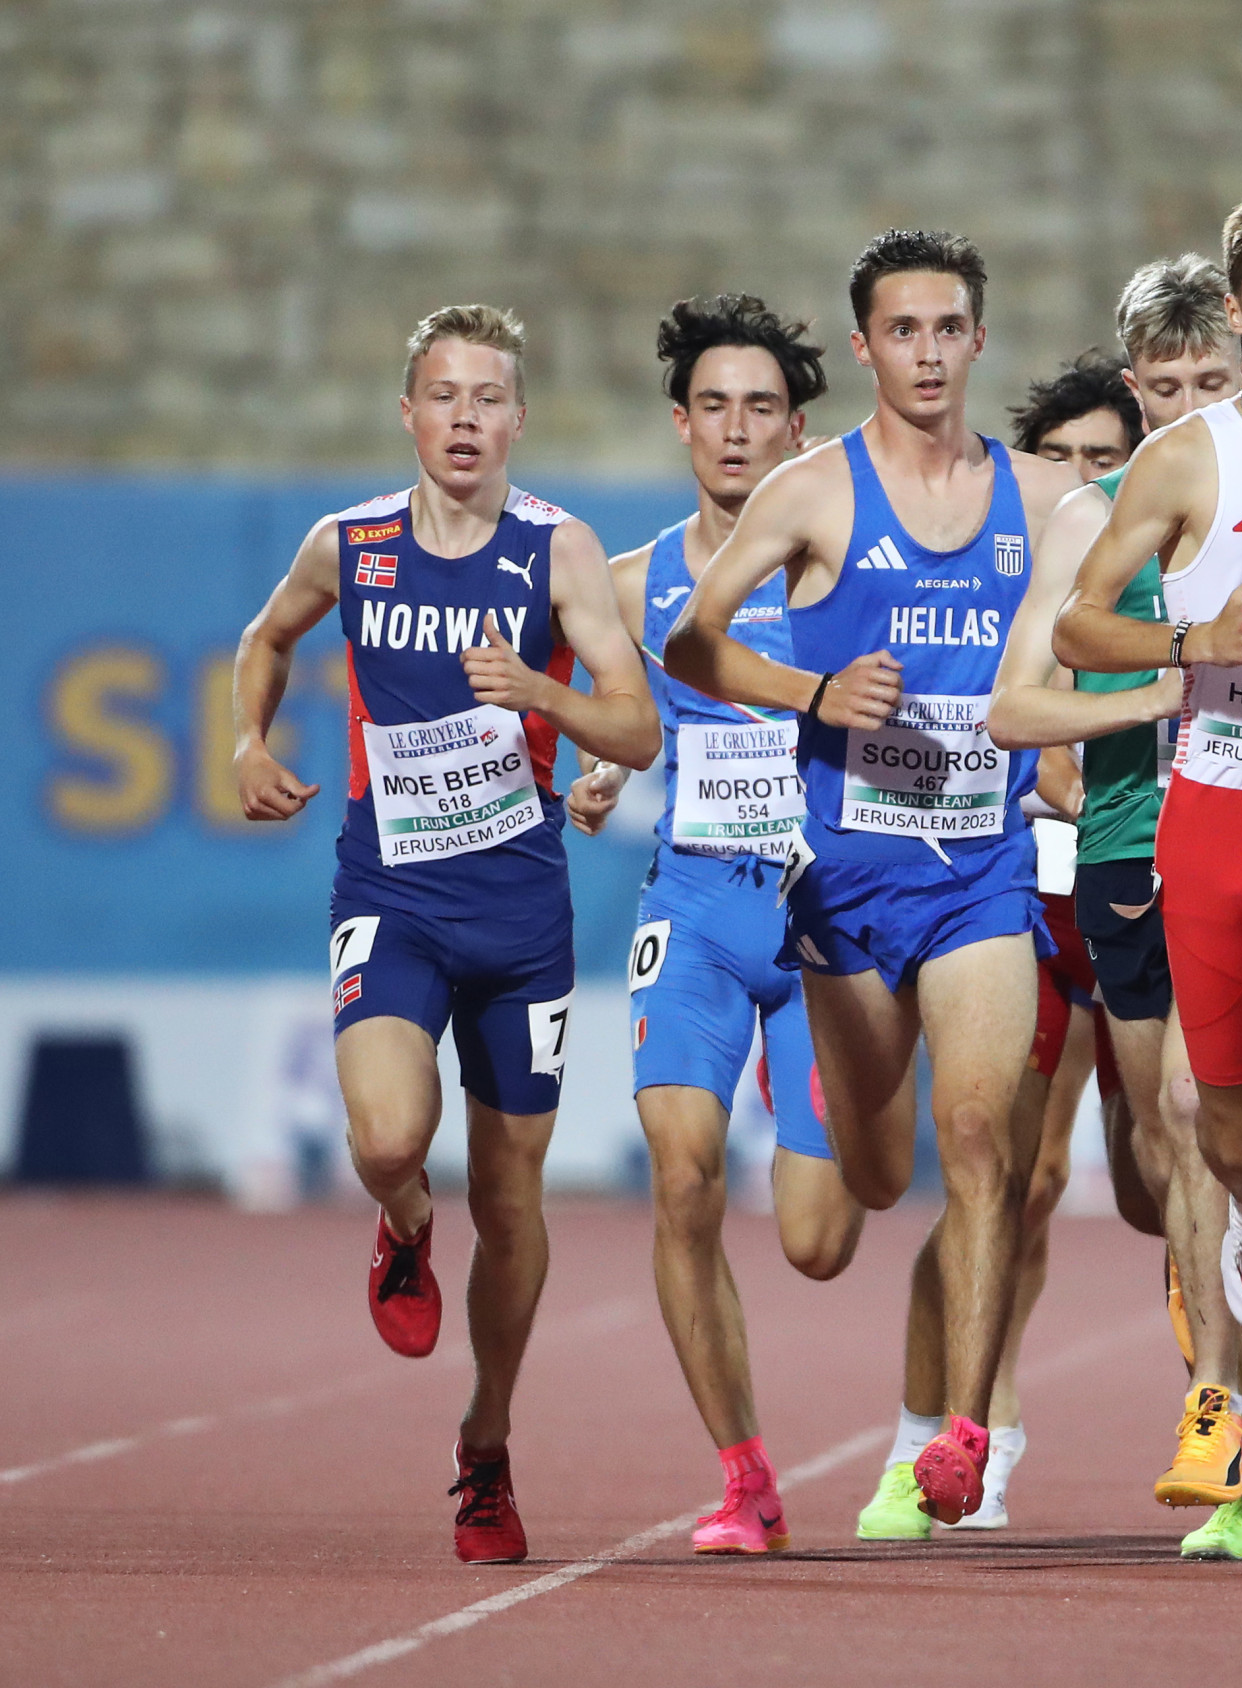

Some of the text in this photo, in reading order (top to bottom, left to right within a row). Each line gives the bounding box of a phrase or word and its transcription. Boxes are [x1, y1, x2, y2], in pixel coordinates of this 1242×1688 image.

[368, 525, 401, 538] EXTRA
[915, 579, 970, 588] AEGEAN
[889, 607, 1000, 647] HELLAS
[907, 699, 974, 721] GRUYÈRE
[388, 732, 406, 749] LE
[408, 717, 476, 748] GRUYÈRE
[888, 719, 970, 730] SWITZERLAND
[396, 738, 476, 758] SWITZERLAND
[705, 728, 786, 749] LE GRUYÈRE
[708, 749, 784, 759] SWITZERLAND
[862, 743, 998, 771] SGOUROS
[383, 752, 522, 796] MOE BERG
[913, 776, 948, 791] 467
[438, 794, 472, 812] 618
[887, 791, 919, 806] RUN
[924, 795, 972, 808] CLEAN
[420, 816, 450, 830] RUN
[453, 801, 501, 825] CLEAN
[738, 803, 769, 819] 554
[852, 808, 996, 830] JERUSALEM 2023
[392, 806, 534, 856] JERUSALEM 2023
[715, 824, 745, 836] RUN
[748, 818, 797, 835] CLEAN
[688, 841, 785, 855] ERUSALEM
[336, 927, 357, 970] 7
[631, 934, 660, 982] 10
[549, 1007, 568, 1057] 7
